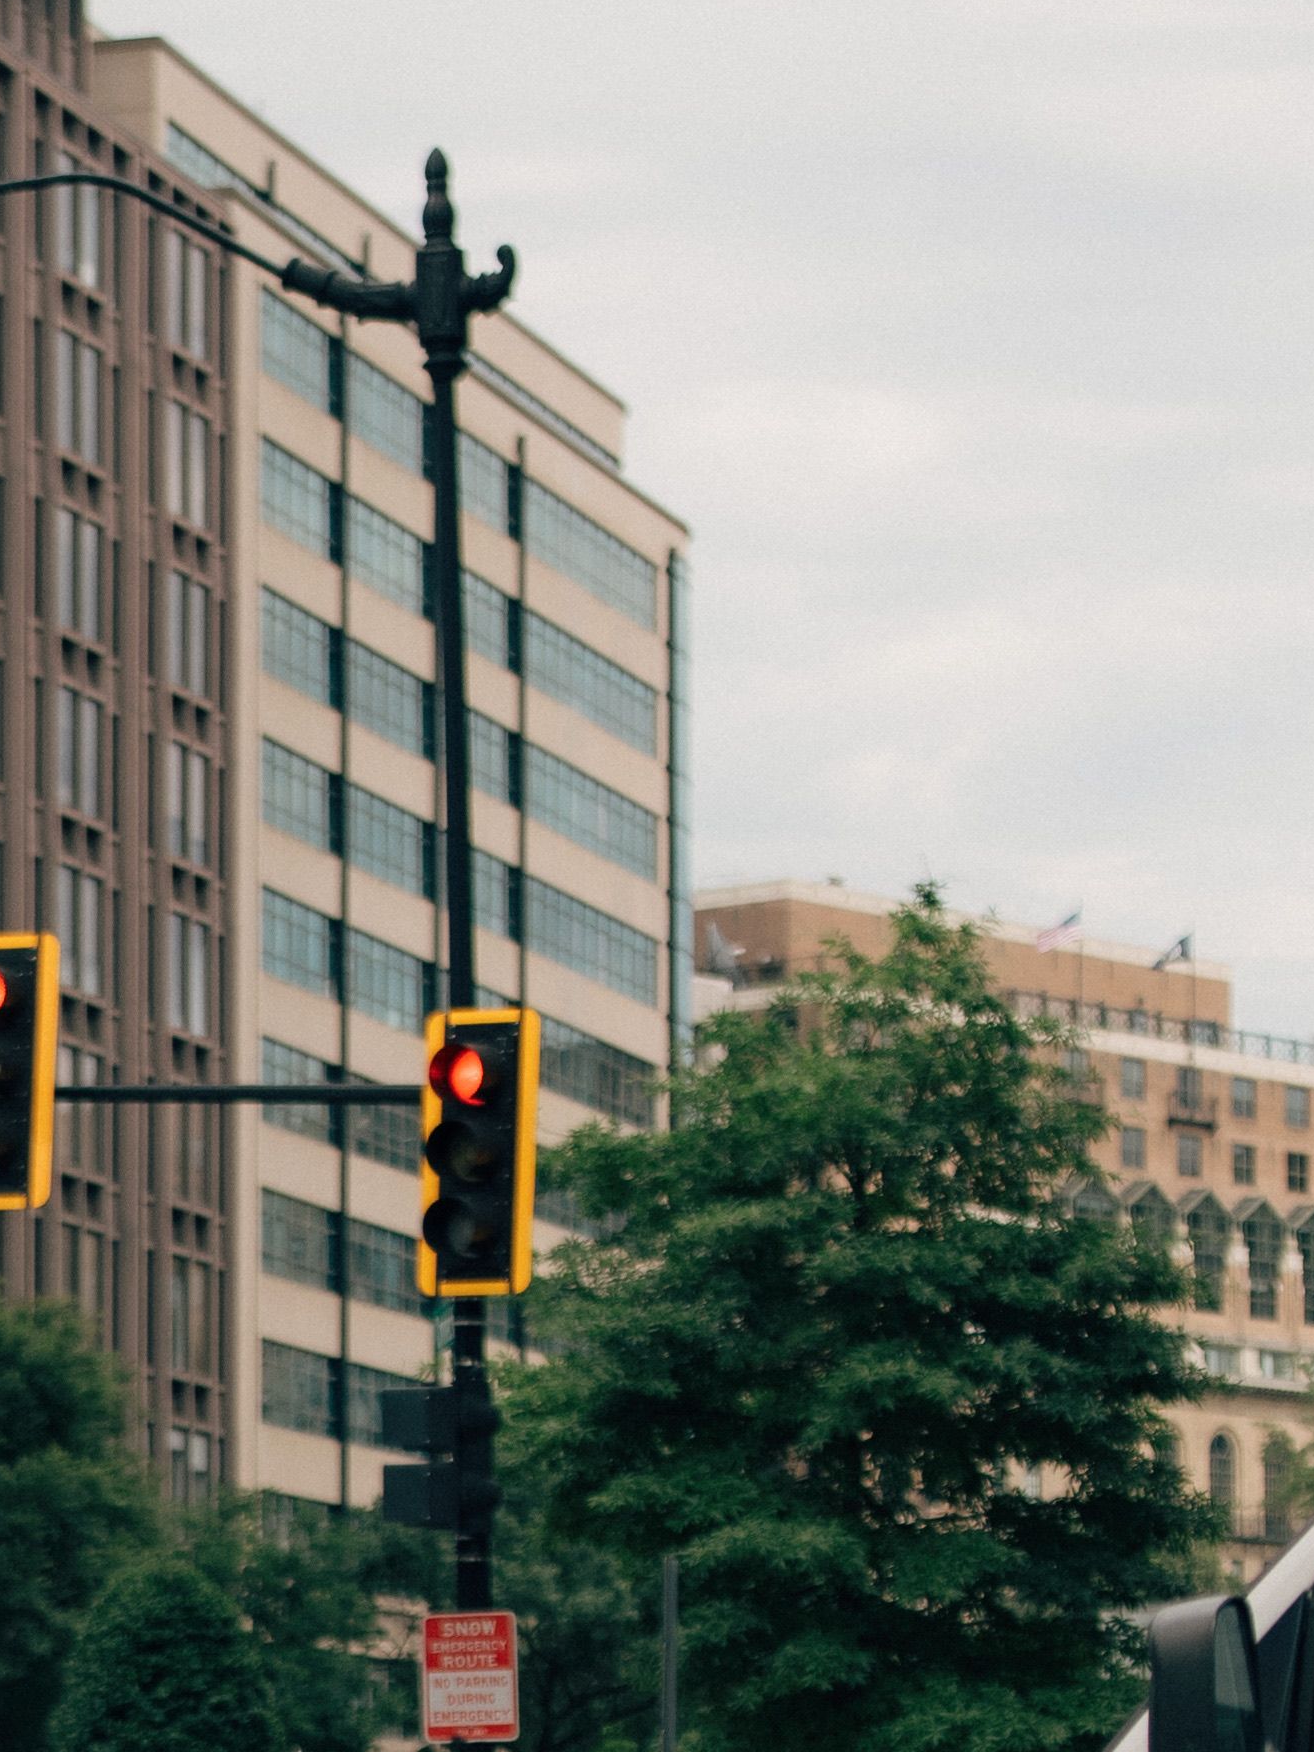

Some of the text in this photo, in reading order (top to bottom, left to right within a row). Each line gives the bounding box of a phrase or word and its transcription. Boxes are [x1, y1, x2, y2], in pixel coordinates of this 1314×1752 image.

[442, 1620, 498, 1638] SNOW
[431, 1639, 508, 1655] EMERGENCY
[443, 1653, 499, 1669] ROUTE
[433, 1675, 510, 1689] NO PARKING
[447, 1692, 496, 1706] DURING
[433, 1709, 512, 1724] EMERGENCY
